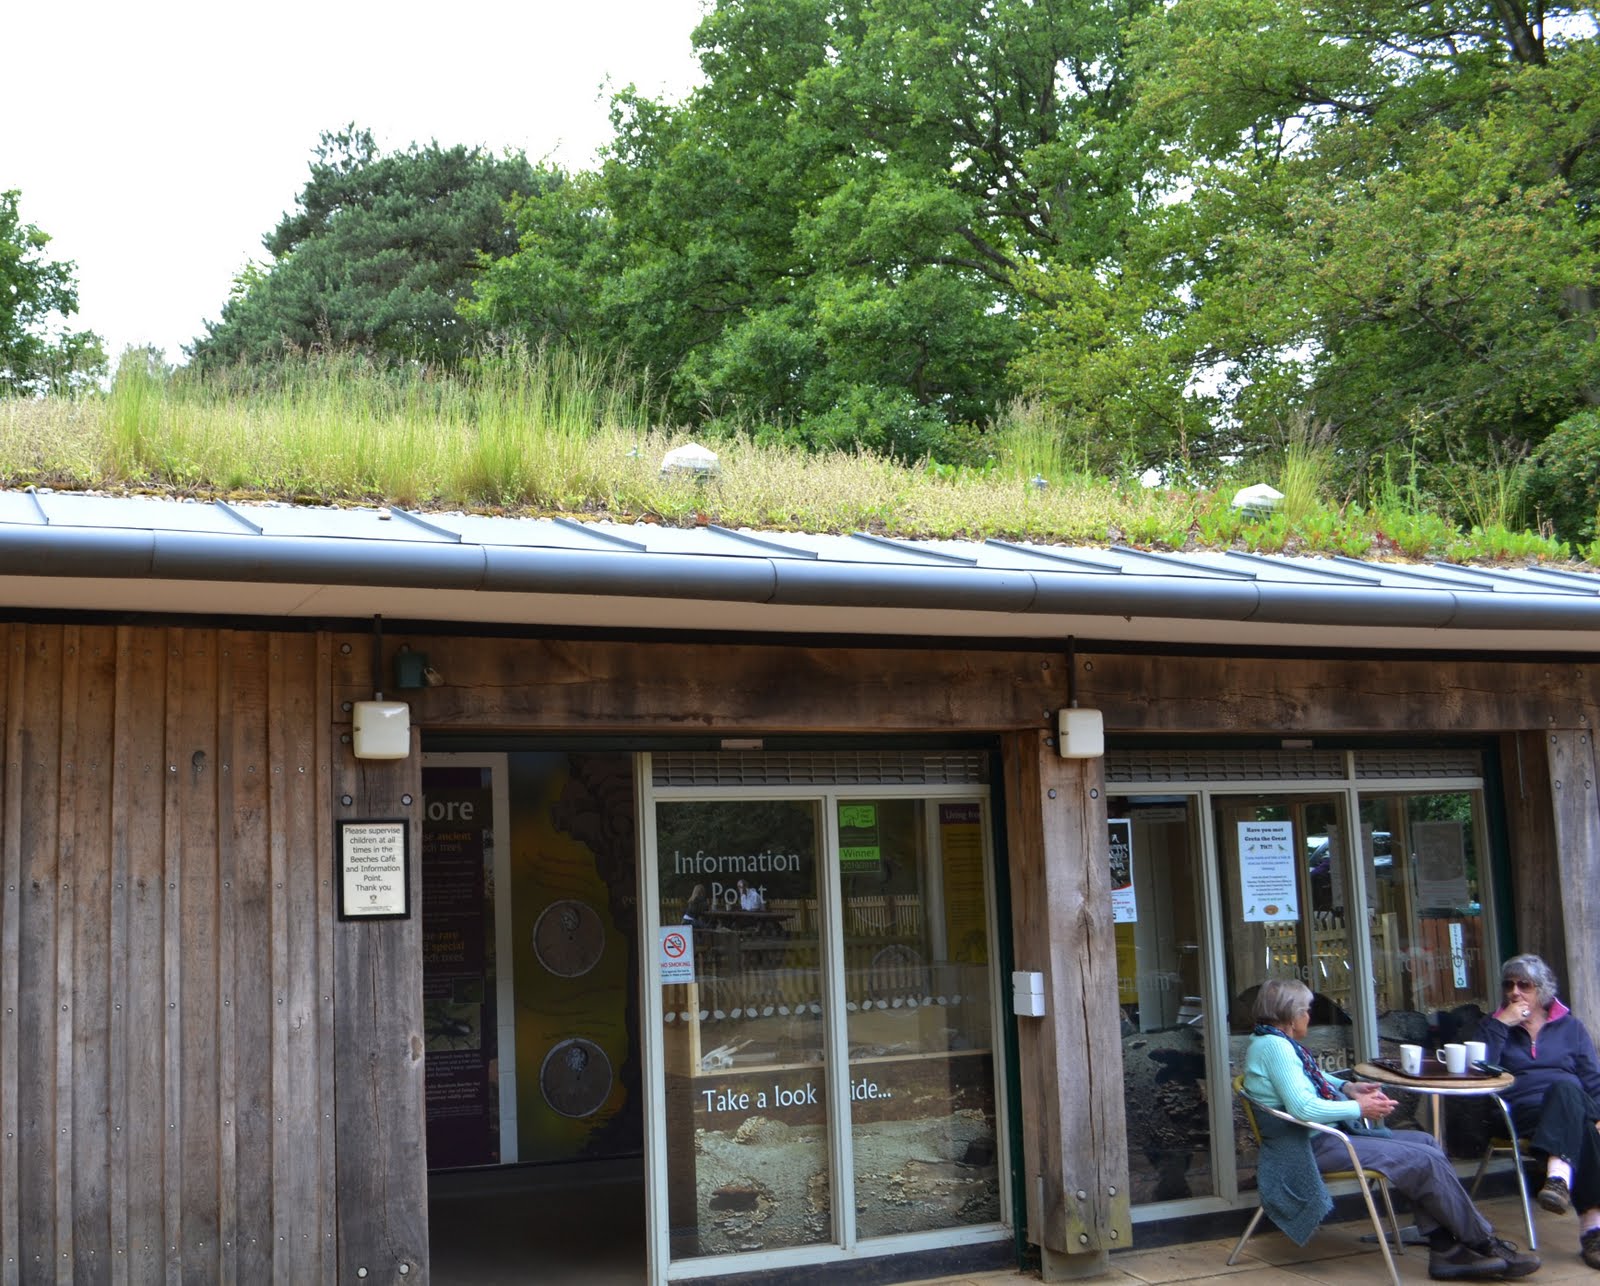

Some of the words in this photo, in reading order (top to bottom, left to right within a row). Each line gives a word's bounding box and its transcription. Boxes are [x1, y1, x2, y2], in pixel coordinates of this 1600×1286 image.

[344, 827, 367, 835] Please
[368, 827, 401, 836] supervise
[349, 836, 377, 844] children
[352, 846, 372, 854] times
[373, 846, 380, 854] in
[350, 855, 379, 863] Beeches
[380, 855, 397, 863] Café
[674, 849, 801, 875] Information
[345, 865, 359, 873] and
[360, 864, 401, 872] Information
[356, 884, 378, 892] Thank
[378, 885, 392, 893] you
[711, 881, 768, 907] Pot
[668, 961, 691, 969] SMOKING
[702, 1088, 750, 1113] Take
[756, 1091, 767, 1109] a
[774, 1082, 818, 1108] look
[849, 1077, 892, 1101] ide...
